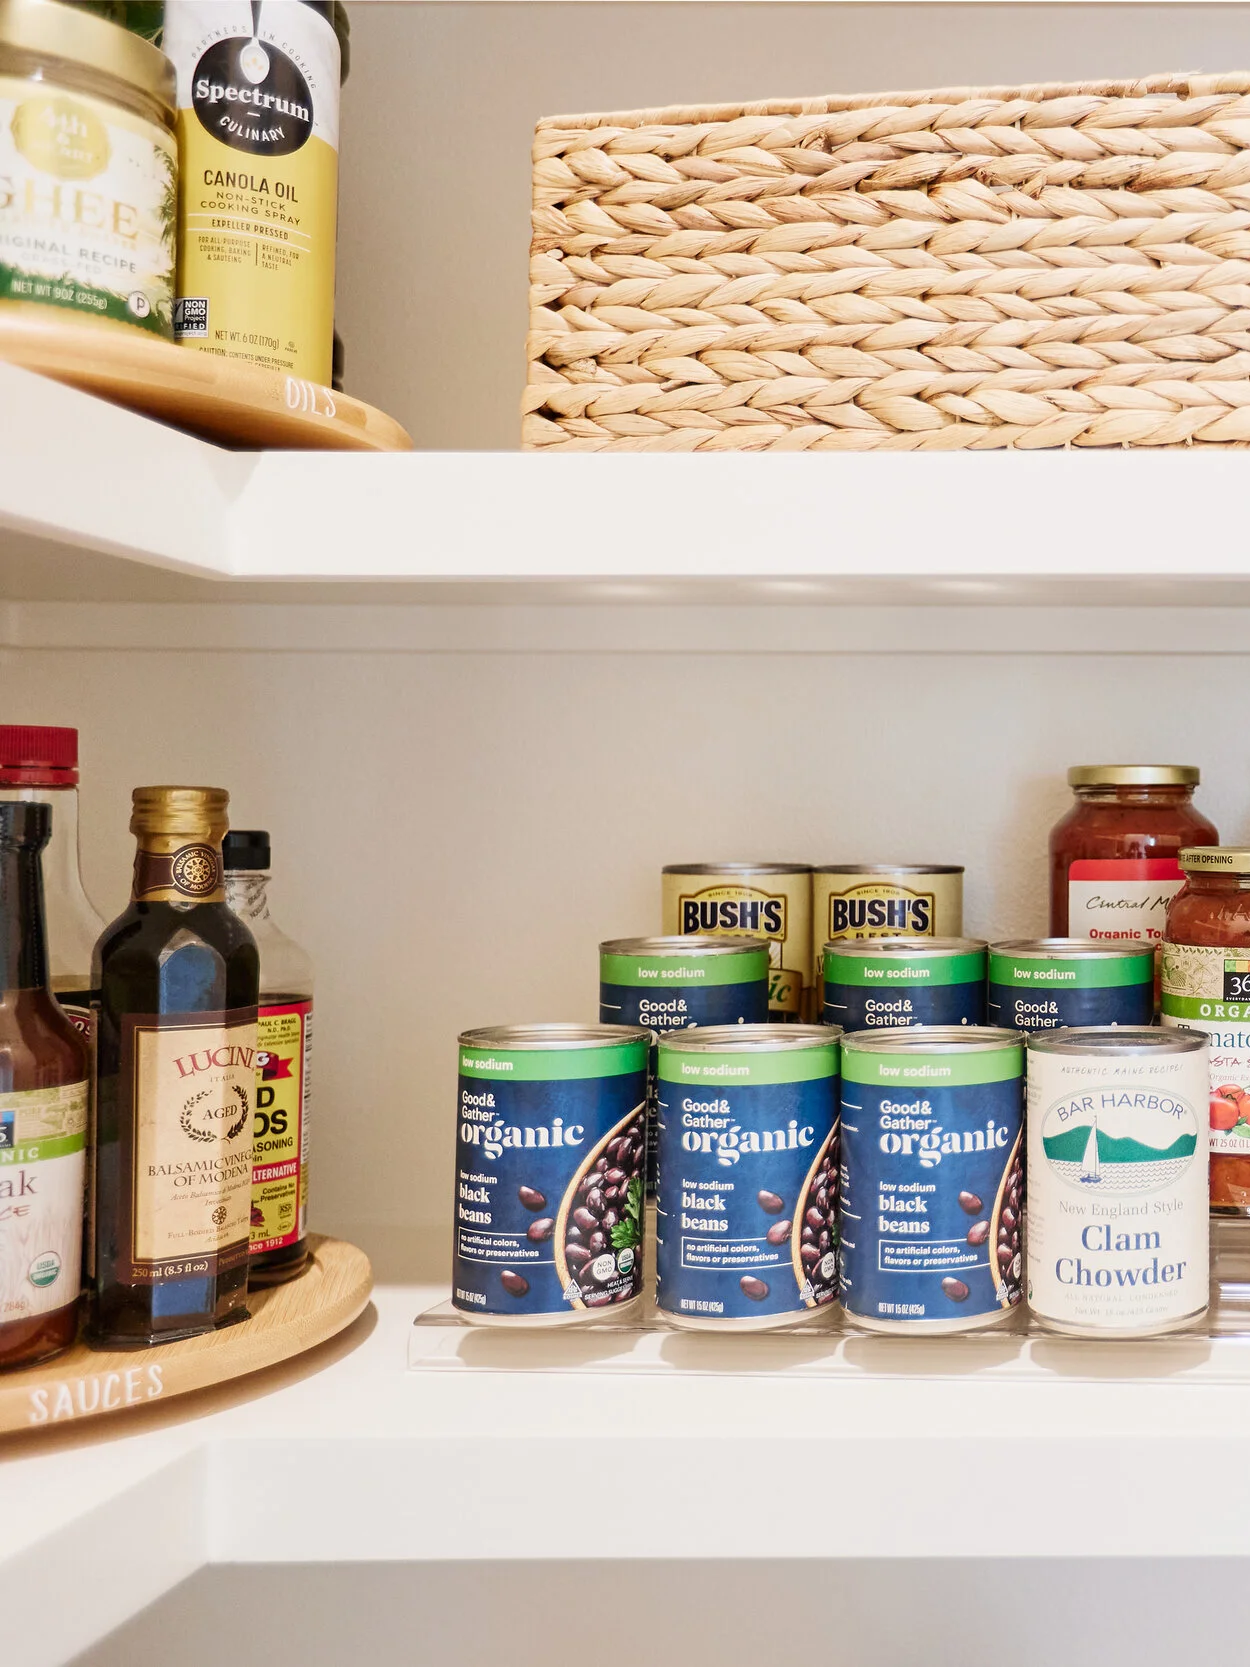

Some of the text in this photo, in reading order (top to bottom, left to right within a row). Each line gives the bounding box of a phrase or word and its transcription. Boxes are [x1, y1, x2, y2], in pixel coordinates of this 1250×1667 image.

[192, 26, 317, 89] PARTNERS COOKING
[196, 79, 310, 123] Spectrum
[219, 116, 286, 142] CULINARY
[204, 169, 298, 203] CANOLA OIL
[216, 191, 286, 211] NON-STICK
[200, 200, 301, 226] COOKING SPRAY
[212, 219, 289, 240] EXPELLER PRESSED
[79, 247, 137, 274] RECIPE
[12, 280, 108, 310] NET (255g)
[184, 308, 206, 316] GMO
[185, 300, 206, 308] NON
[214, 330, 228, 341] NET
[249, 334, 258, 345] OZ
[259, 335, 280, 350] (170g)
[271, 357, 294, 369] PRESSURE
[286, 376, 337, 418] OILS
[1185, 854, 1200, 863] AFTER
[1201, 855, 1233, 864] OPENING
[1085, 895, 1150, 910] Central
[683, 900, 784, 934] BUSH'S
[833, 898, 931, 933] BUSH'S
[1089, 928, 1141, 940] Organic
[638, 967, 705, 978] low sodium
[863, 967, 931, 979] low sodium
[1013, 968, 1076, 981] low sodium
[639, 999, 688, 1013] Good&
[865, 999, 913, 1013] Good&
[1015, 1000, 1059, 1015] Good&
[639, 1013, 687, 1026] Gather
[865, 1013, 913, 1026] Gather
[1015, 1014, 1058, 1028] Gather
[172, 1044, 255, 1079] LUCINI
[462, 1055, 514, 1071] low sodium
[681, 1062, 750, 1076] low sodium
[879, 1064, 951, 1077] low sodium
[1060, 1064, 1145, 1076] AUTHENTIC MAINE
[462, 1090, 496, 1107] Good&
[682, 1098, 730, 1113] Good&
[202, 1104, 238, 1120] AGED
[462, 1105, 495, 1122] Gather
[879, 1100, 932, 1115] Good&
[1057, 1093, 1184, 1122] BAR HARBOR
[682, 1113, 728, 1129] Gather
[879, 1115, 930, 1130] Gather
[460, 1117, 585, 1160] organic
[682, 1120, 815, 1166] organic
[879, 1120, 1009, 1168] organic
[1228, 1139, 1237, 1148] OZ
[148, 1159, 224, 1176] BALSAMIC
[174, 1164, 248, 1187] OF MODENA
[253, 1162, 297, 1181] LTERNATIVE
[470, 1172, 498, 1185] sodium
[682, 1179, 734, 1191] low sodium
[879, 1180, 936, 1192] low sodium
[262, 1185, 288, 1195] Contains
[459, 1183, 490, 1204] black
[682, 1192, 727, 1211] black
[879, 1195, 928, 1213] black
[1059, 1198, 1184, 1220] New England Style
[458, 1203, 492, 1225] beans
[681, 1213, 729, 1232] beans
[878, 1215, 930, 1233] beans
[266, 1237, 283, 1248] 1912
[467, 1235, 492, 1247] artificial
[1081, 1224, 1162, 1252] Clam
[697, 1243, 729, 1253] artificial
[730, 1244, 760, 1253] colors,
[896, 1246, 931, 1255] artificial
[932, 1246, 961, 1255] colors,
[686, 1252, 711, 1263] flavors
[722, 1253, 779, 1264] preservatives
[884, 1255, 911, 1266] flavors
[923, 1254, 978, 1267] preservatives
[132, 1261, 209, 1277] 250 ml (8.5 oz)
[1055, 1257, 1187, 1288] Chowder
[29, 1364, 164, 1424] SAUCES
